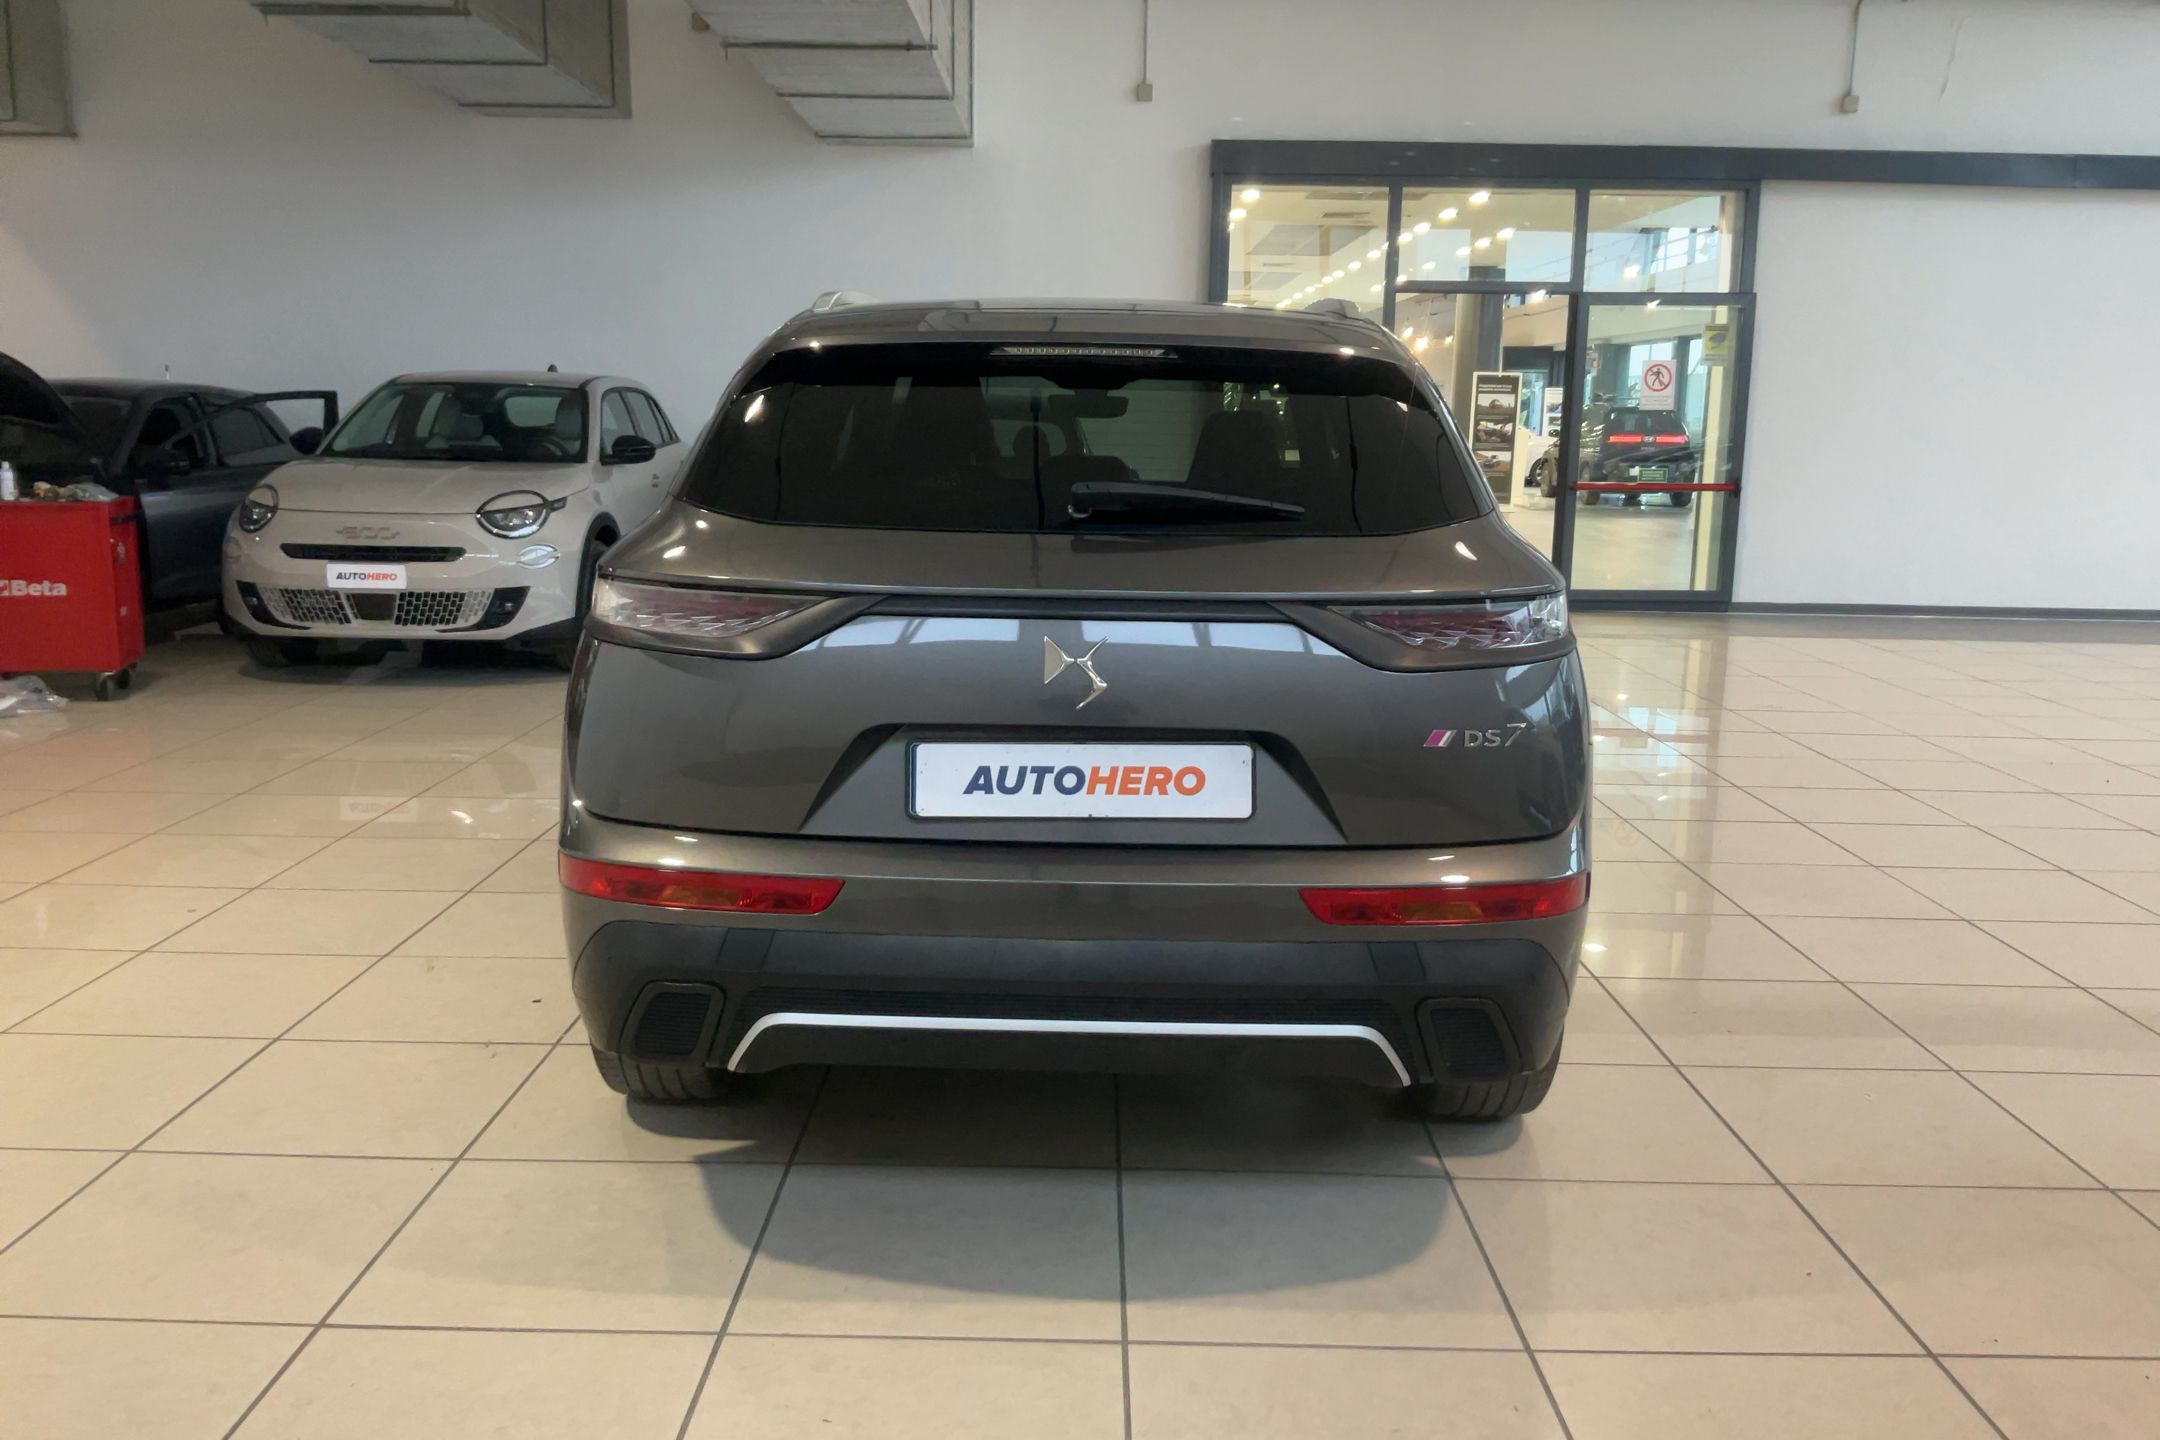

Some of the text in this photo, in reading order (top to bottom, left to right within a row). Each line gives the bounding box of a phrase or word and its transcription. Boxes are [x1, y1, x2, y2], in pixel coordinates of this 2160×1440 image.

[335, 572, 398, 581] AUTOHERO
[10, 579, 67, 596] Beta
[962, 765, 1206, 796] AUTOHERO
